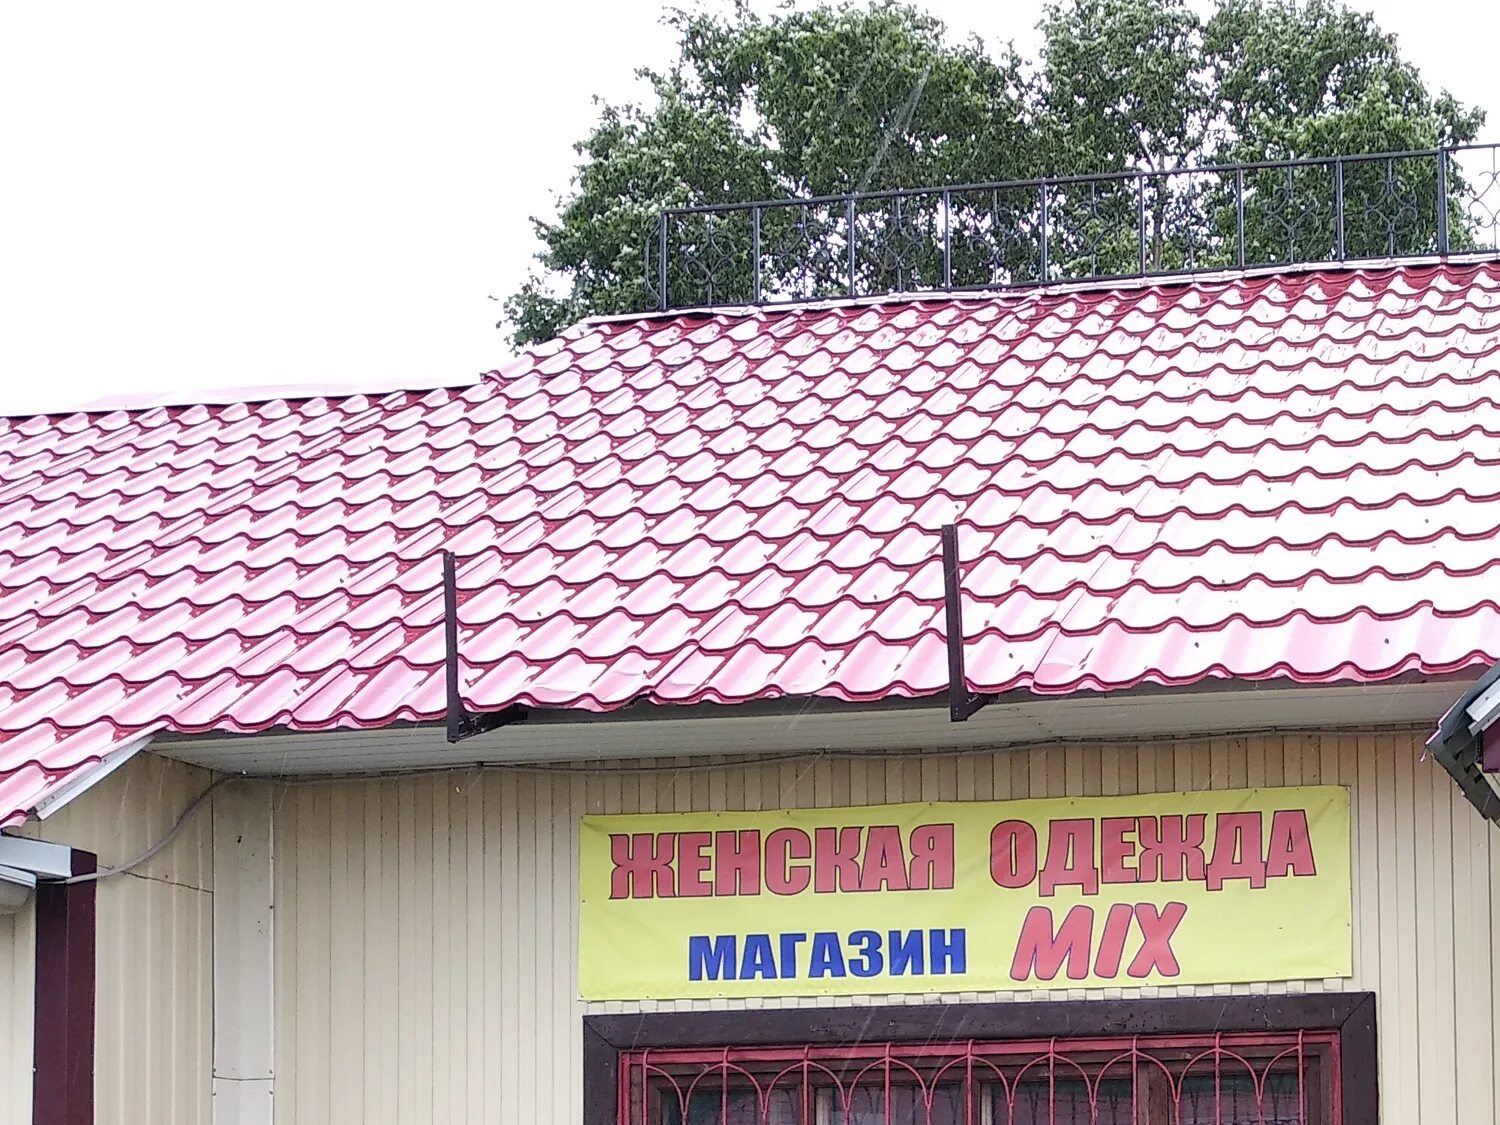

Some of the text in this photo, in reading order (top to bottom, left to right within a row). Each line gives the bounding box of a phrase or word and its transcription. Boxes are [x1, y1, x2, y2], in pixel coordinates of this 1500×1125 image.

[610, 809, 1317, 898] ЖЕНСКАЯ ОДЕЖДА
[688, 902, 1188, 981] МАГАЗИН MIX
